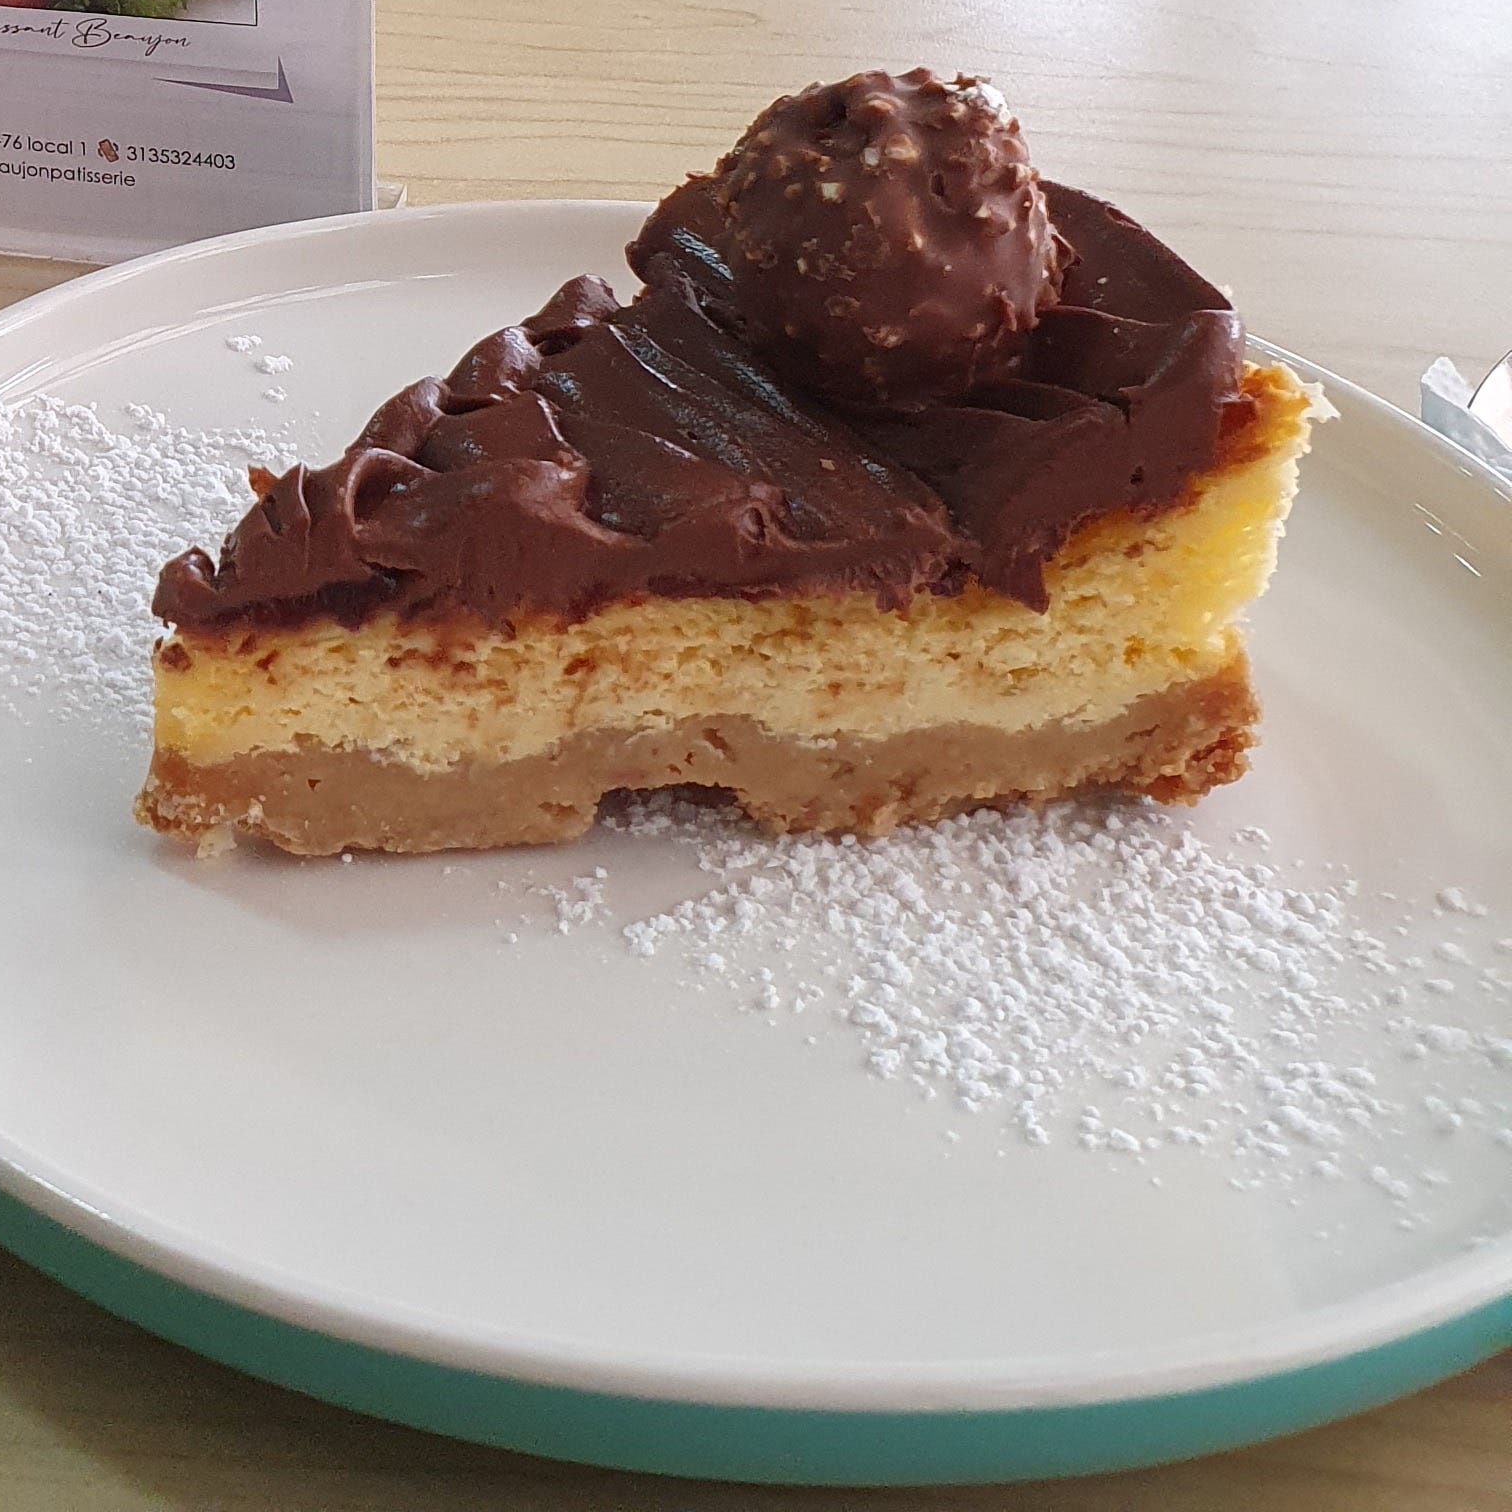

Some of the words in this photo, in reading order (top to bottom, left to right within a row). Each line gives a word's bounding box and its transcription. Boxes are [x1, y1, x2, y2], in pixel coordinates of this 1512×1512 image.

[71, 17, 191, 56] Beaujon
[27, 135, 73, 156] local
[126, 145, 236, 170] 3135324403
